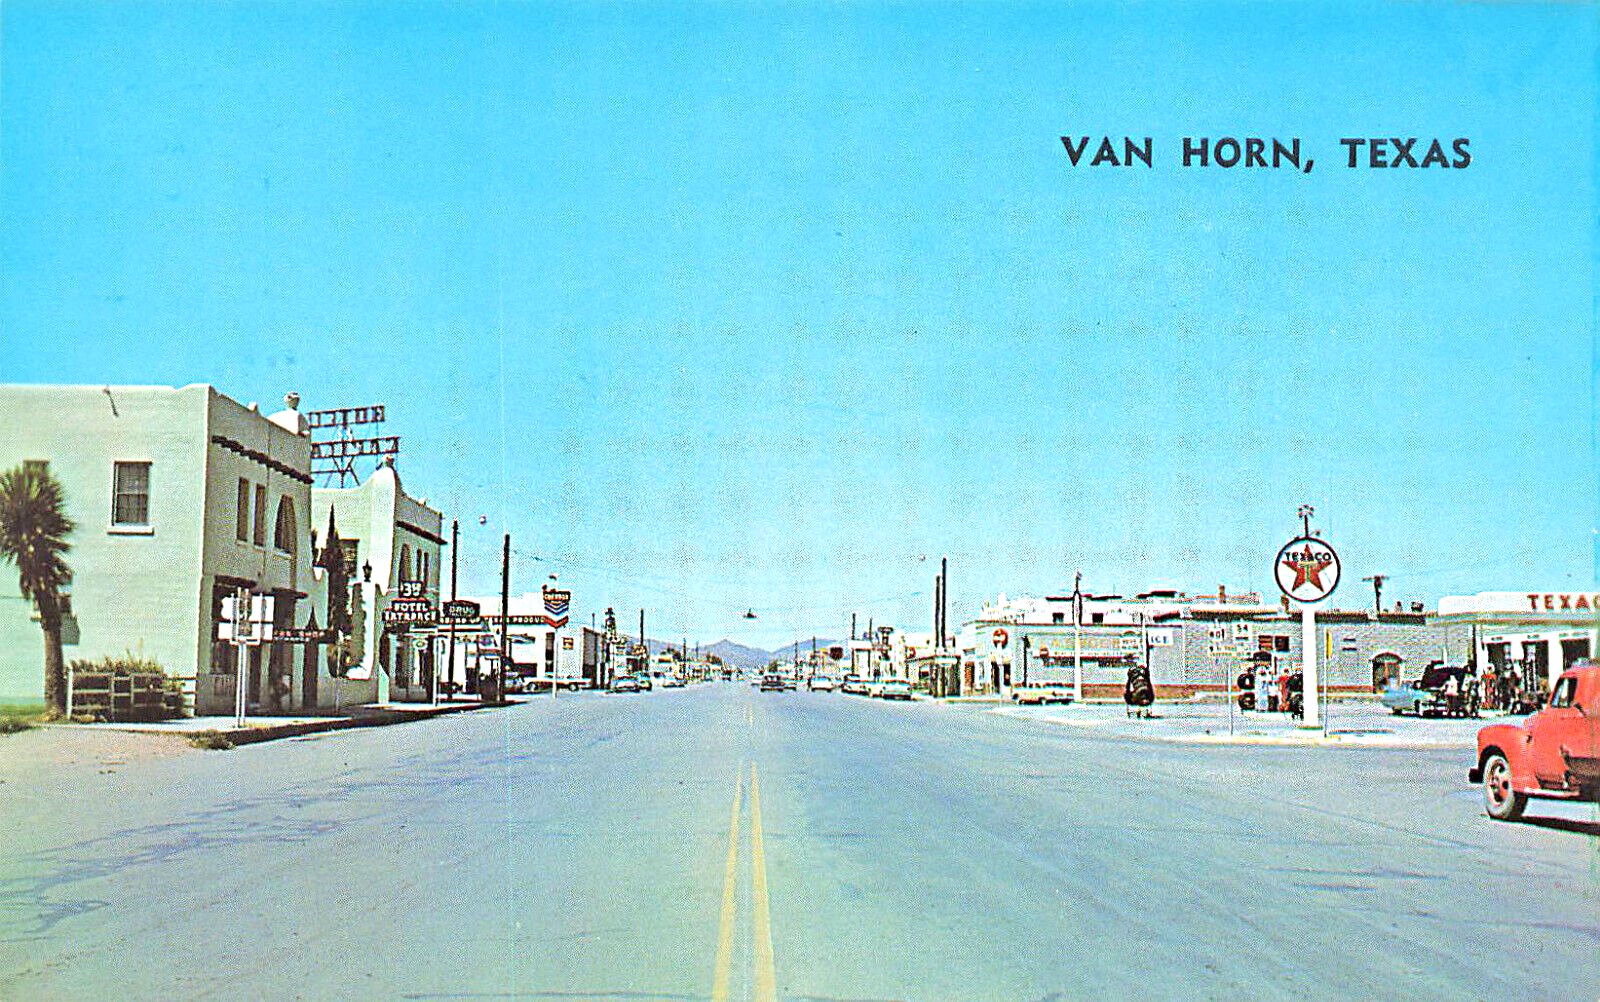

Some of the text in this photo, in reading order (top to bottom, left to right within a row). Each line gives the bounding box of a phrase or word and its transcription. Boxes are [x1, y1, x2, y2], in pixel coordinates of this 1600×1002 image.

[1285, 552, 1332, 564] TEXACO
[1527, 594, 1600, 609] TEXAC
[513, 616, 546, 625] PRODUC
[1150, 634, 1169, 645] ICE
